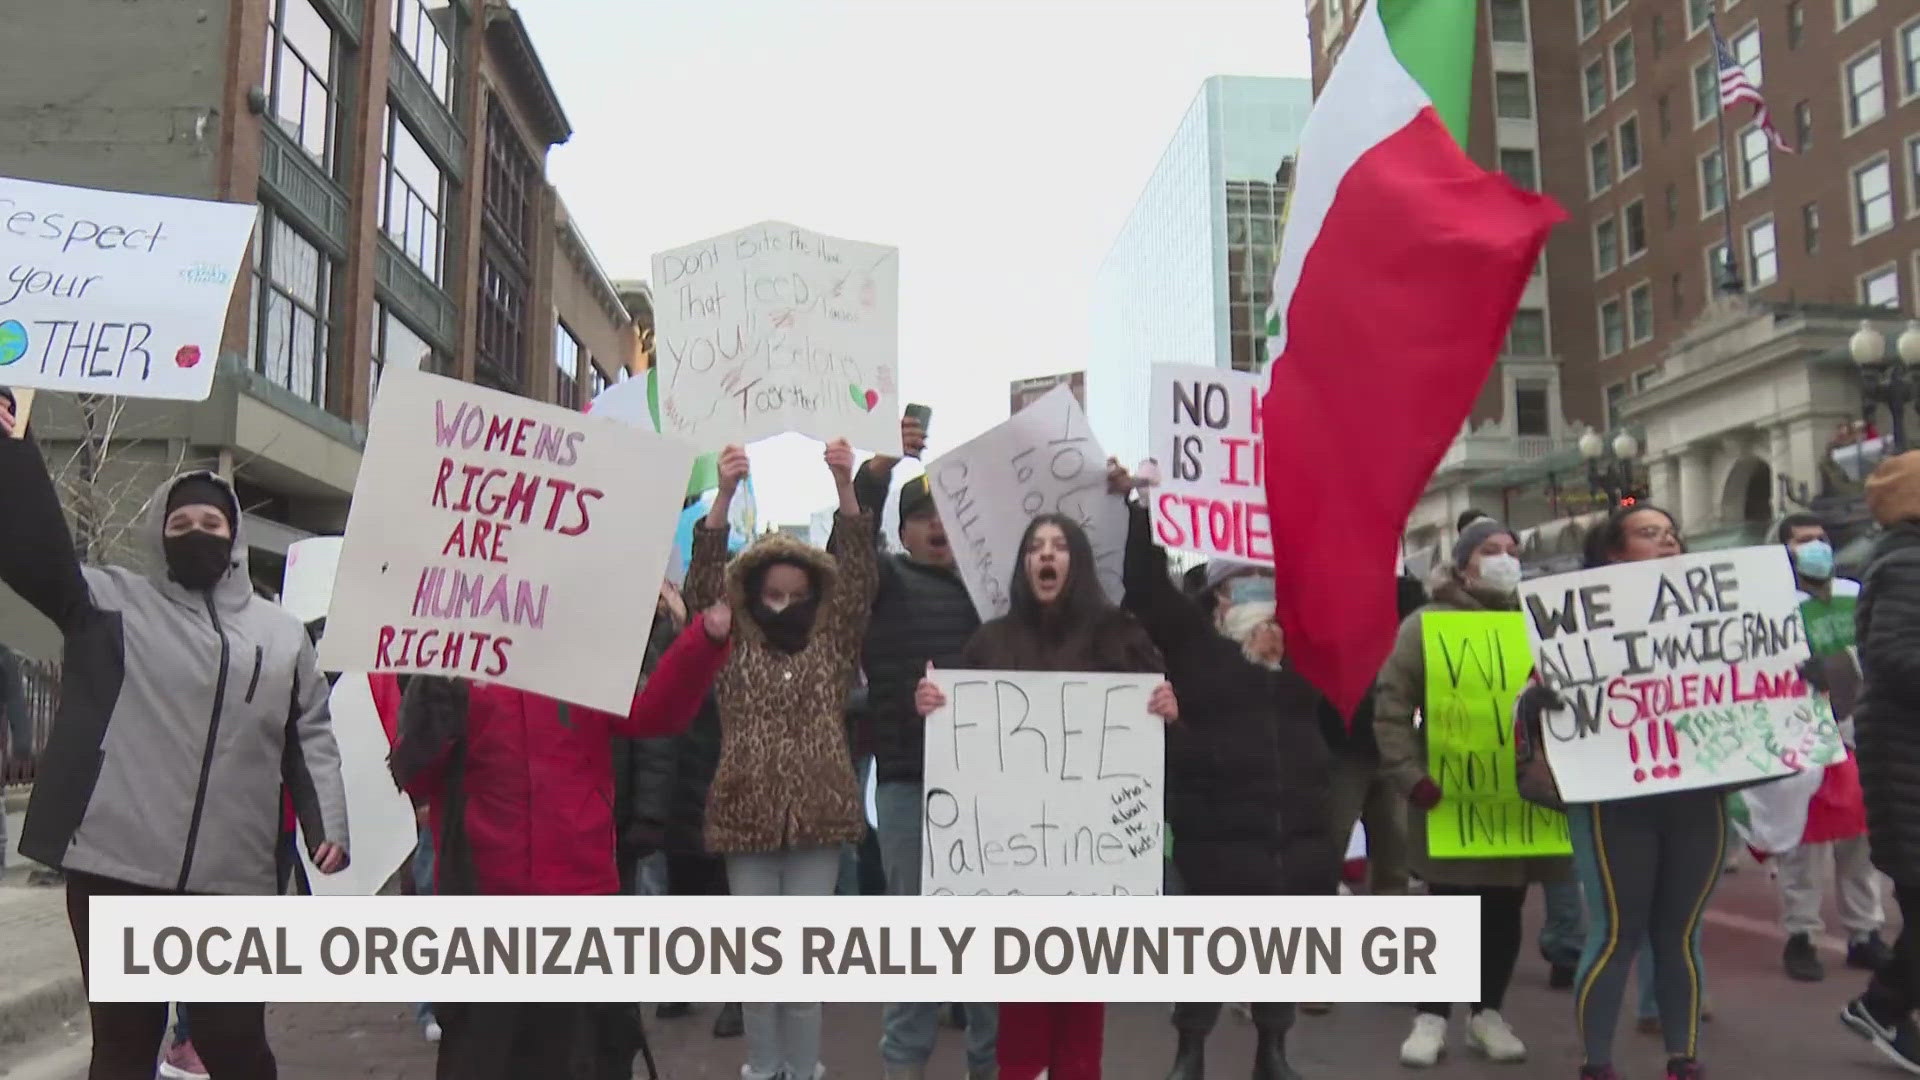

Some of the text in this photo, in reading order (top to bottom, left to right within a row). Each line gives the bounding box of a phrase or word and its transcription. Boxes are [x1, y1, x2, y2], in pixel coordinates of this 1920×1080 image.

[0, 264, 102, 305] your
[435, 399, 585, 466] WOMENS
[1173, 379, 1230, 430] NO
[1173, 435, 1203, 481] IS
[431, 457, 605, 536] RIGHTS
[442, 518, 512, 562] ARE
[411, 566, 549, 629] HUMAN
[1525, 562, 1739, 640] WE ARE
[375, 625, 513, 676] RIGHTS
[1539, 638, 1608, 692] ALL
[952, 679, 1140, 780] FREE
[1549, 687, 1602, 742] ON
[1608, 672, 1724, 728] STOLEN
[925, 786, 1125, 879] Palestine
